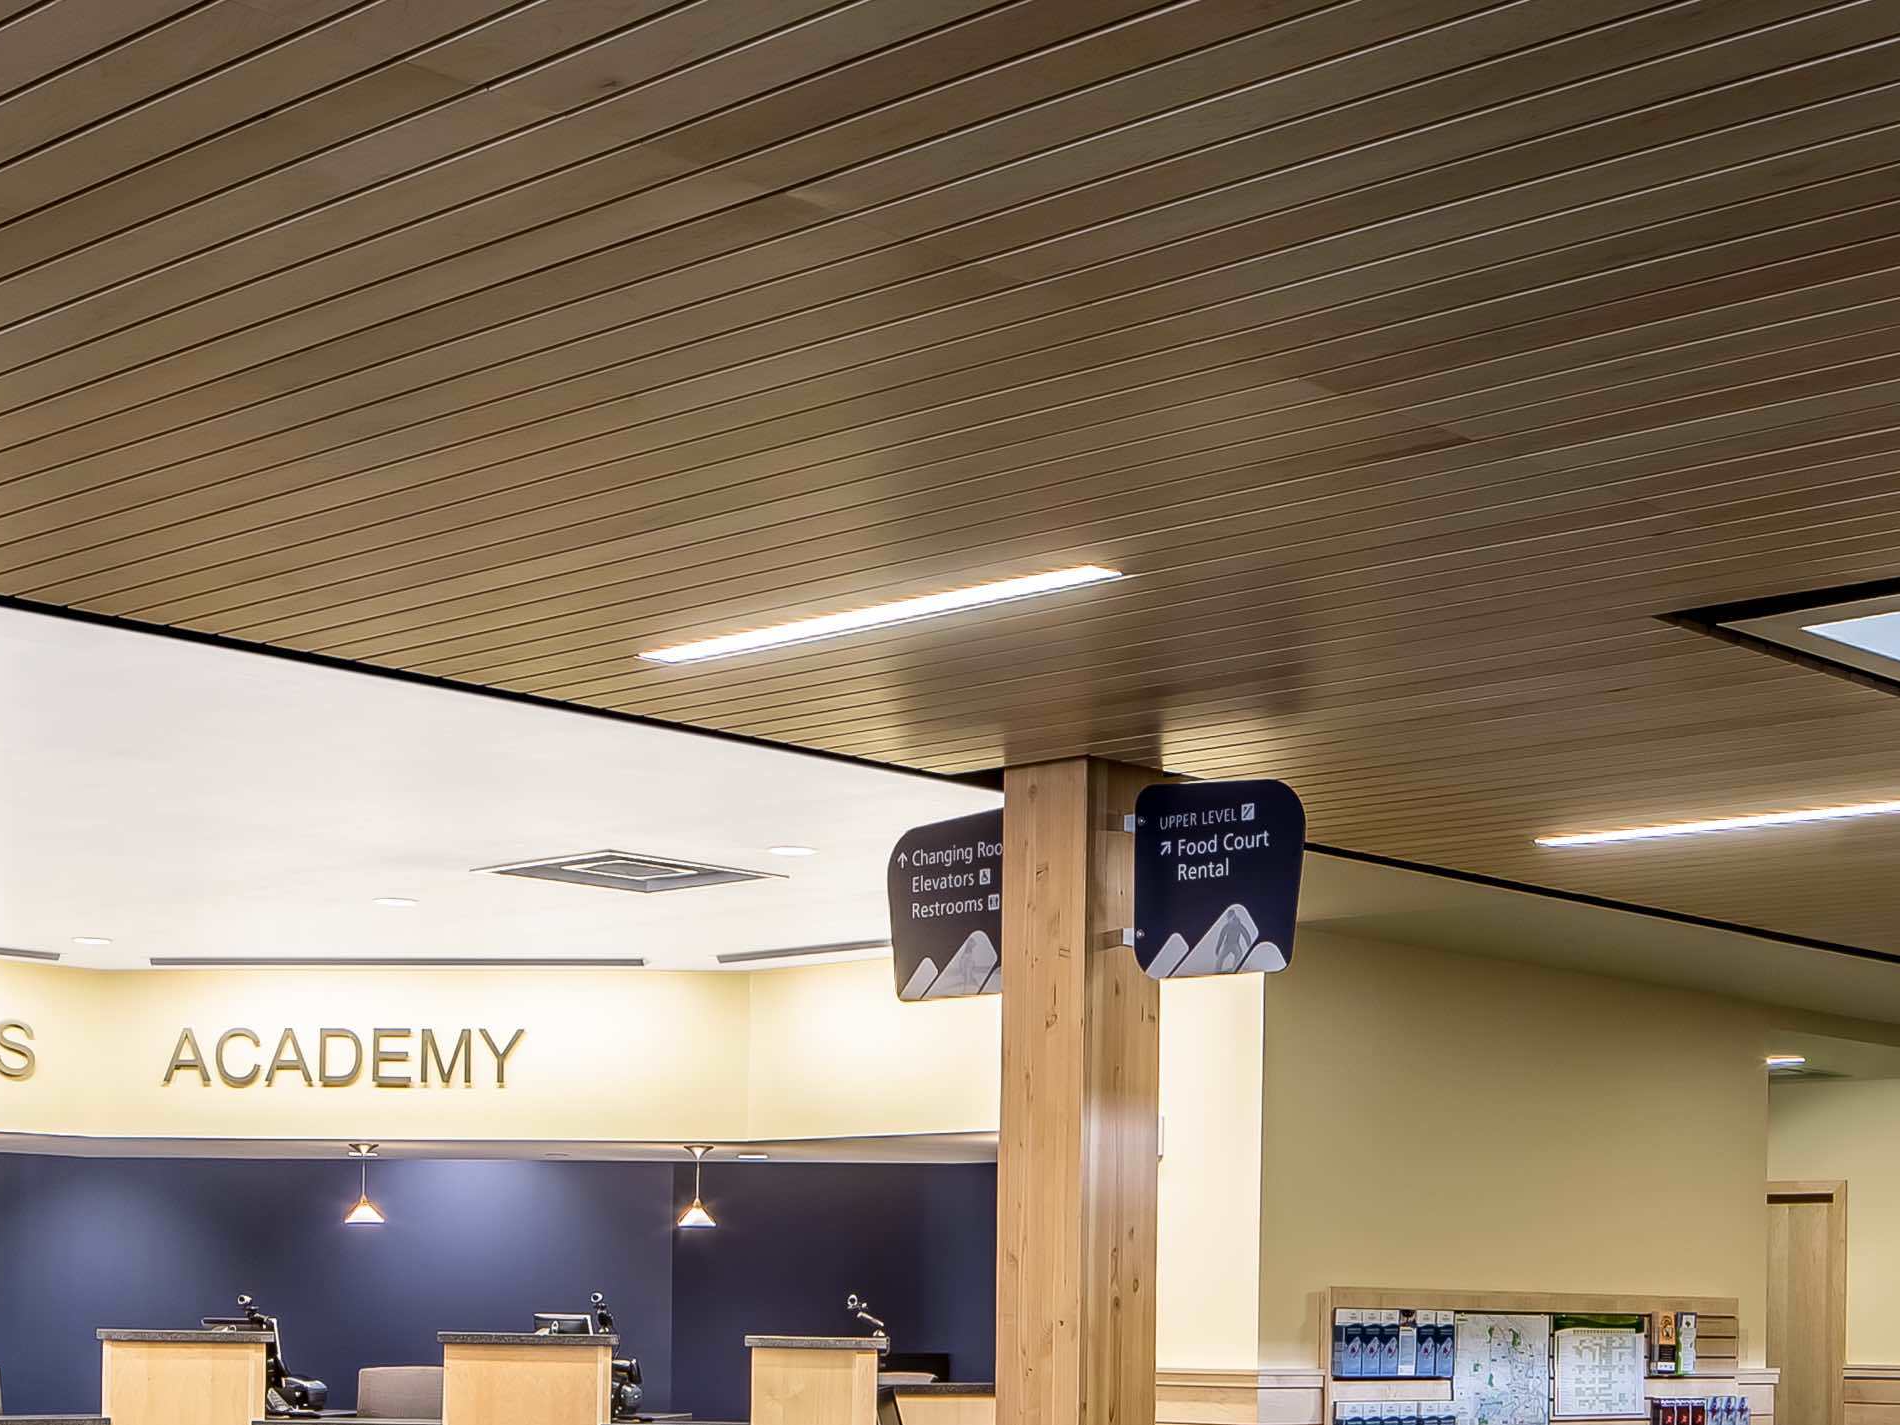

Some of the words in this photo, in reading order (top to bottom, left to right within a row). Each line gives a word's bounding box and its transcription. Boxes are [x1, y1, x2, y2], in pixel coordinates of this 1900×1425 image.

[1160, 812, 1197, 830] UPPER
[1202, 808, 1237, 825] LEVEL
[1178, 834, 1218, 856] Food
[1223, 830, 1269, 851] Court
[912, 844, 973, 867] Changing
[1178, 858, 1229, 880] Rental
[912, 873, 975, 893] Elevators
[912, 899, 984, 919] Restrooms
[161, 1025, 526, 1089] ACADEMY
